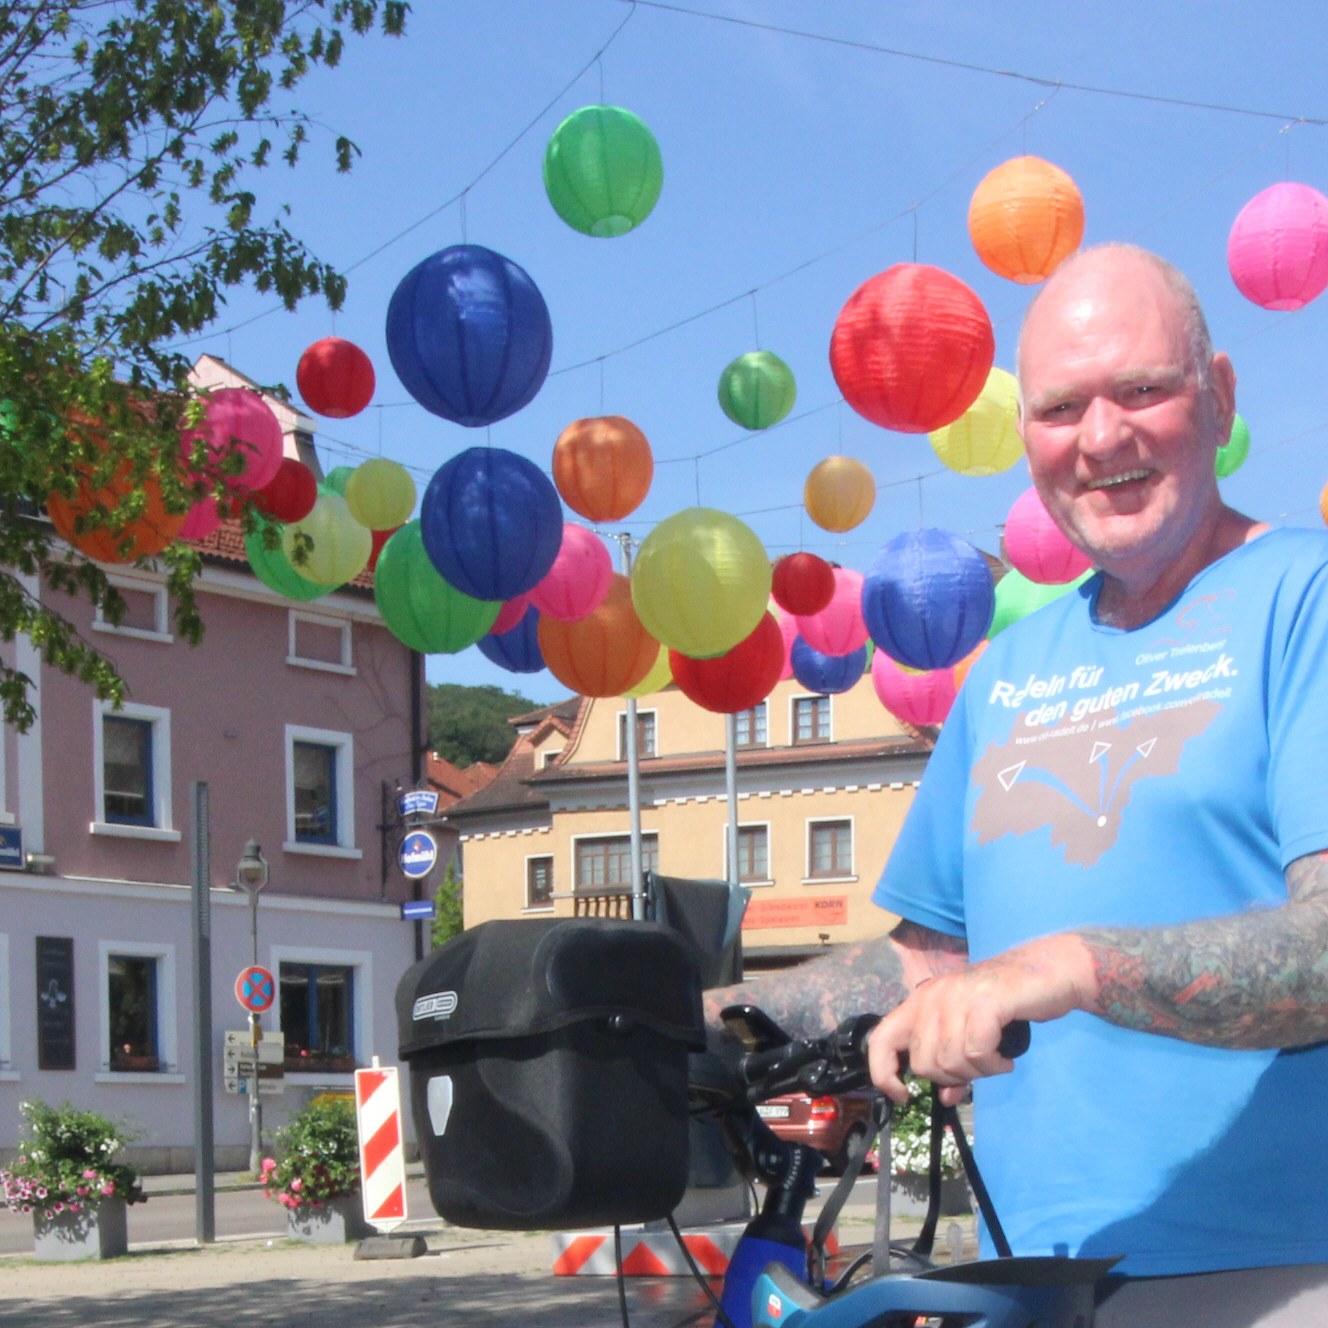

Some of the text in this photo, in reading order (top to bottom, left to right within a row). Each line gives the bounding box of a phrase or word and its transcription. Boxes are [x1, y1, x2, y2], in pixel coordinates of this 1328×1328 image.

[1024, 653, 1239, 727] den guten Zweck.
[1069, 665, 1104, 689] für
